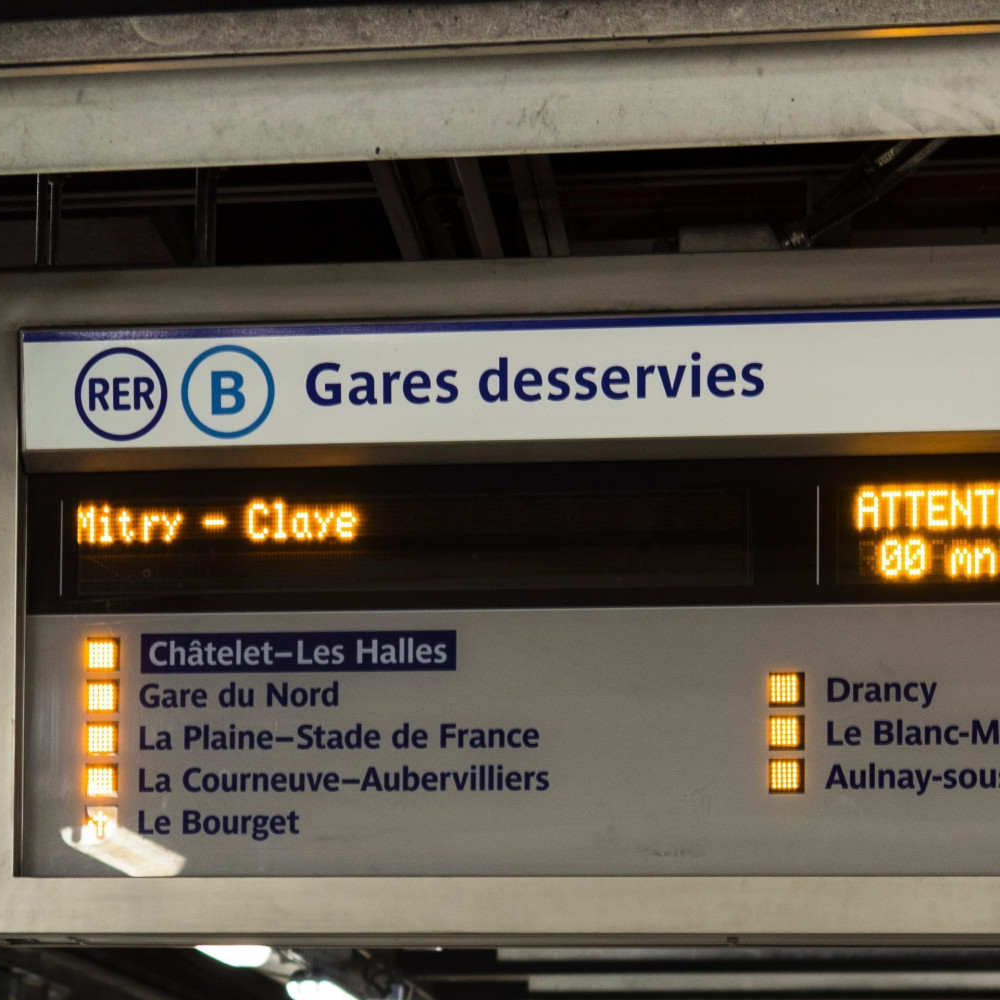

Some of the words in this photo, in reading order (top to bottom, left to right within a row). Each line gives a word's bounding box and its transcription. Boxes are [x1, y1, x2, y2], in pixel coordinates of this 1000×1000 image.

[88, 377, 155, 412] RER
[211, 370, 246, 416] B
[305, 362, 459, 406] Gares
[478, 351, 765, 403] desservies
[77, 502, 183, 544] Mitry
[248, 500, 358, 541] Claye
[857, 487, 1000, 529] ATTENT
[880, 537, 926, 577] 00
[950, 546, 997, 577] mn
[356, 637, 447, 665] Halles
[139, 683, 208, 709] Gare
[218, 682, 255, 708] du
[266, 681, 340, 708] Nord
[827, 677, 938, 709] Drancy
[139, 726, 173, 750] La
[391, 723, 428, 749] de
[439, 723, 540, 749] France
[827, 720, 862, 746] Le
[138, 768, 172, 793] La
[825, 762, 1000, 796] Aulnay-sou
[137, 810, 171, 835] Le
[182, 810, 300, 842] Bourget
